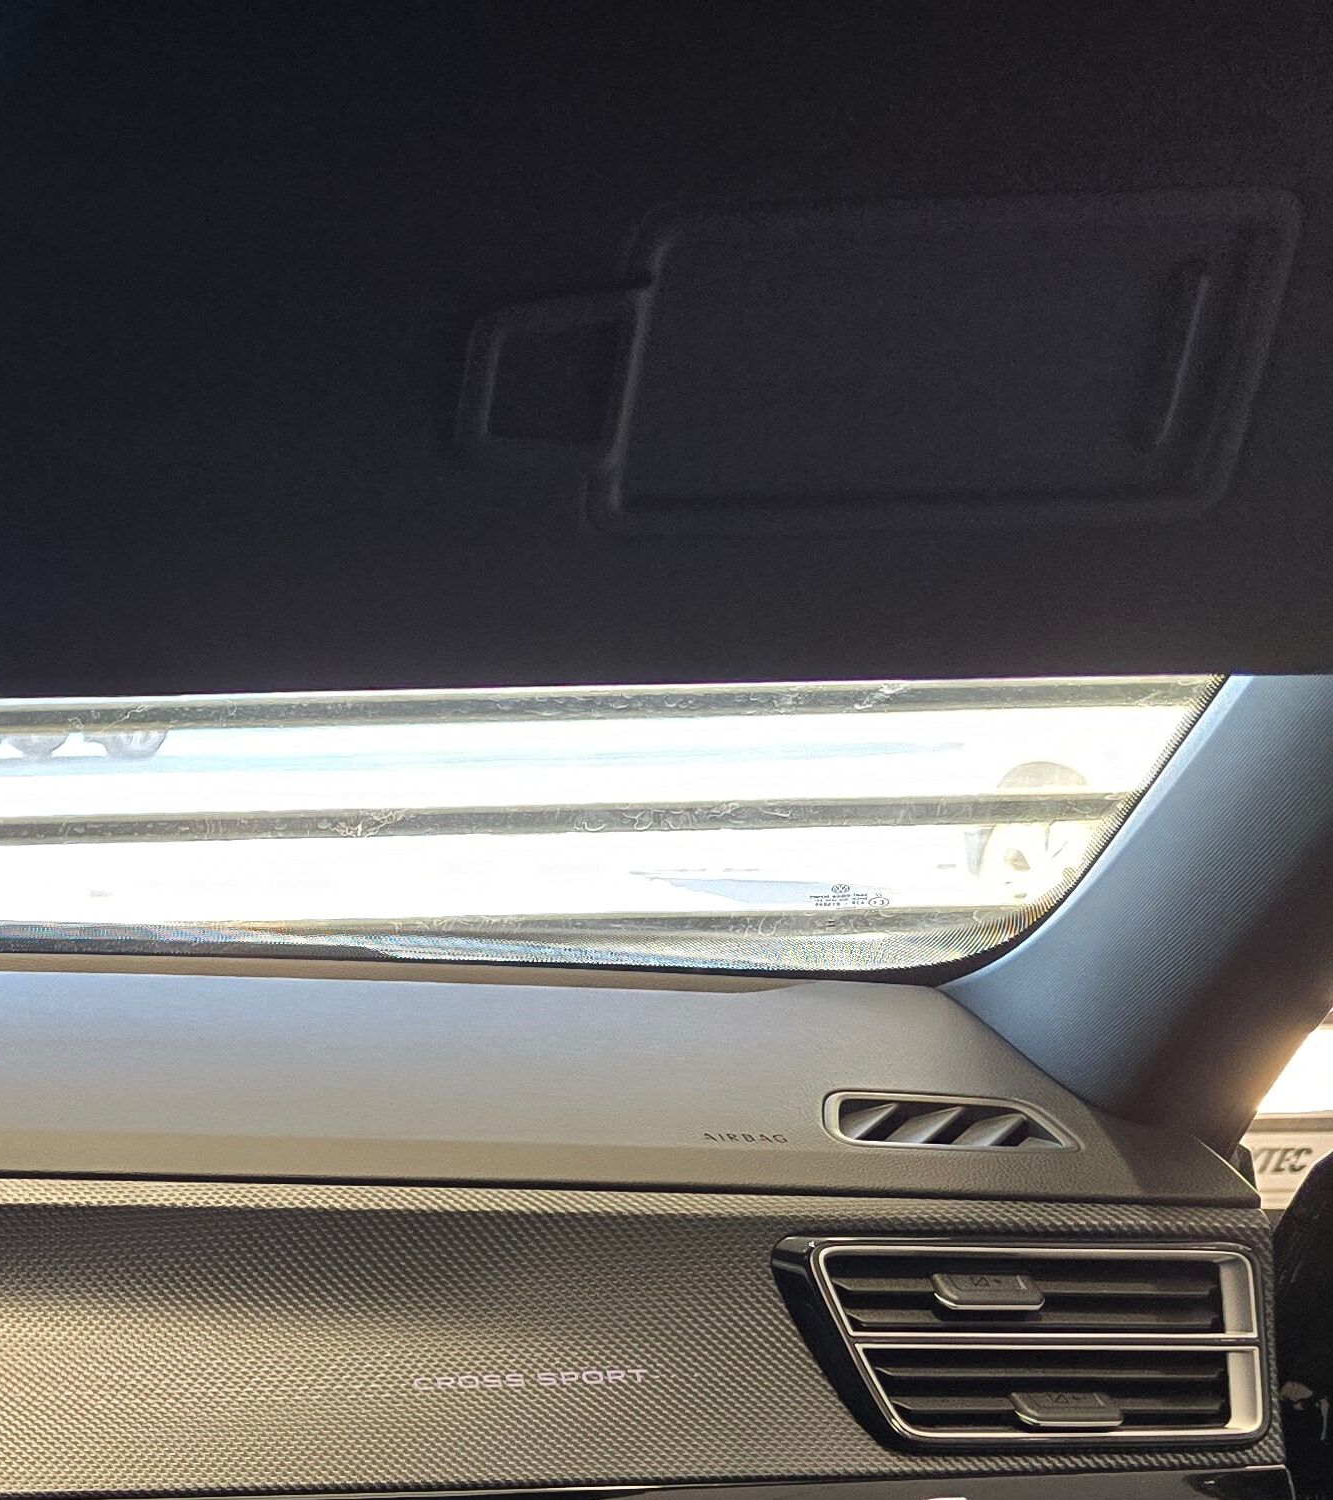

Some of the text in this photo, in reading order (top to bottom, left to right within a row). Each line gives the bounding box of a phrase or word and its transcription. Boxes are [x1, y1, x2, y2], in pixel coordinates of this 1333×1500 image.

[703, 1132, 790, 1144] AIRBAG
[1253, 1147, 1313, 1175] TEC
[413, 1369, 649, 1392] CROSS SPORT
